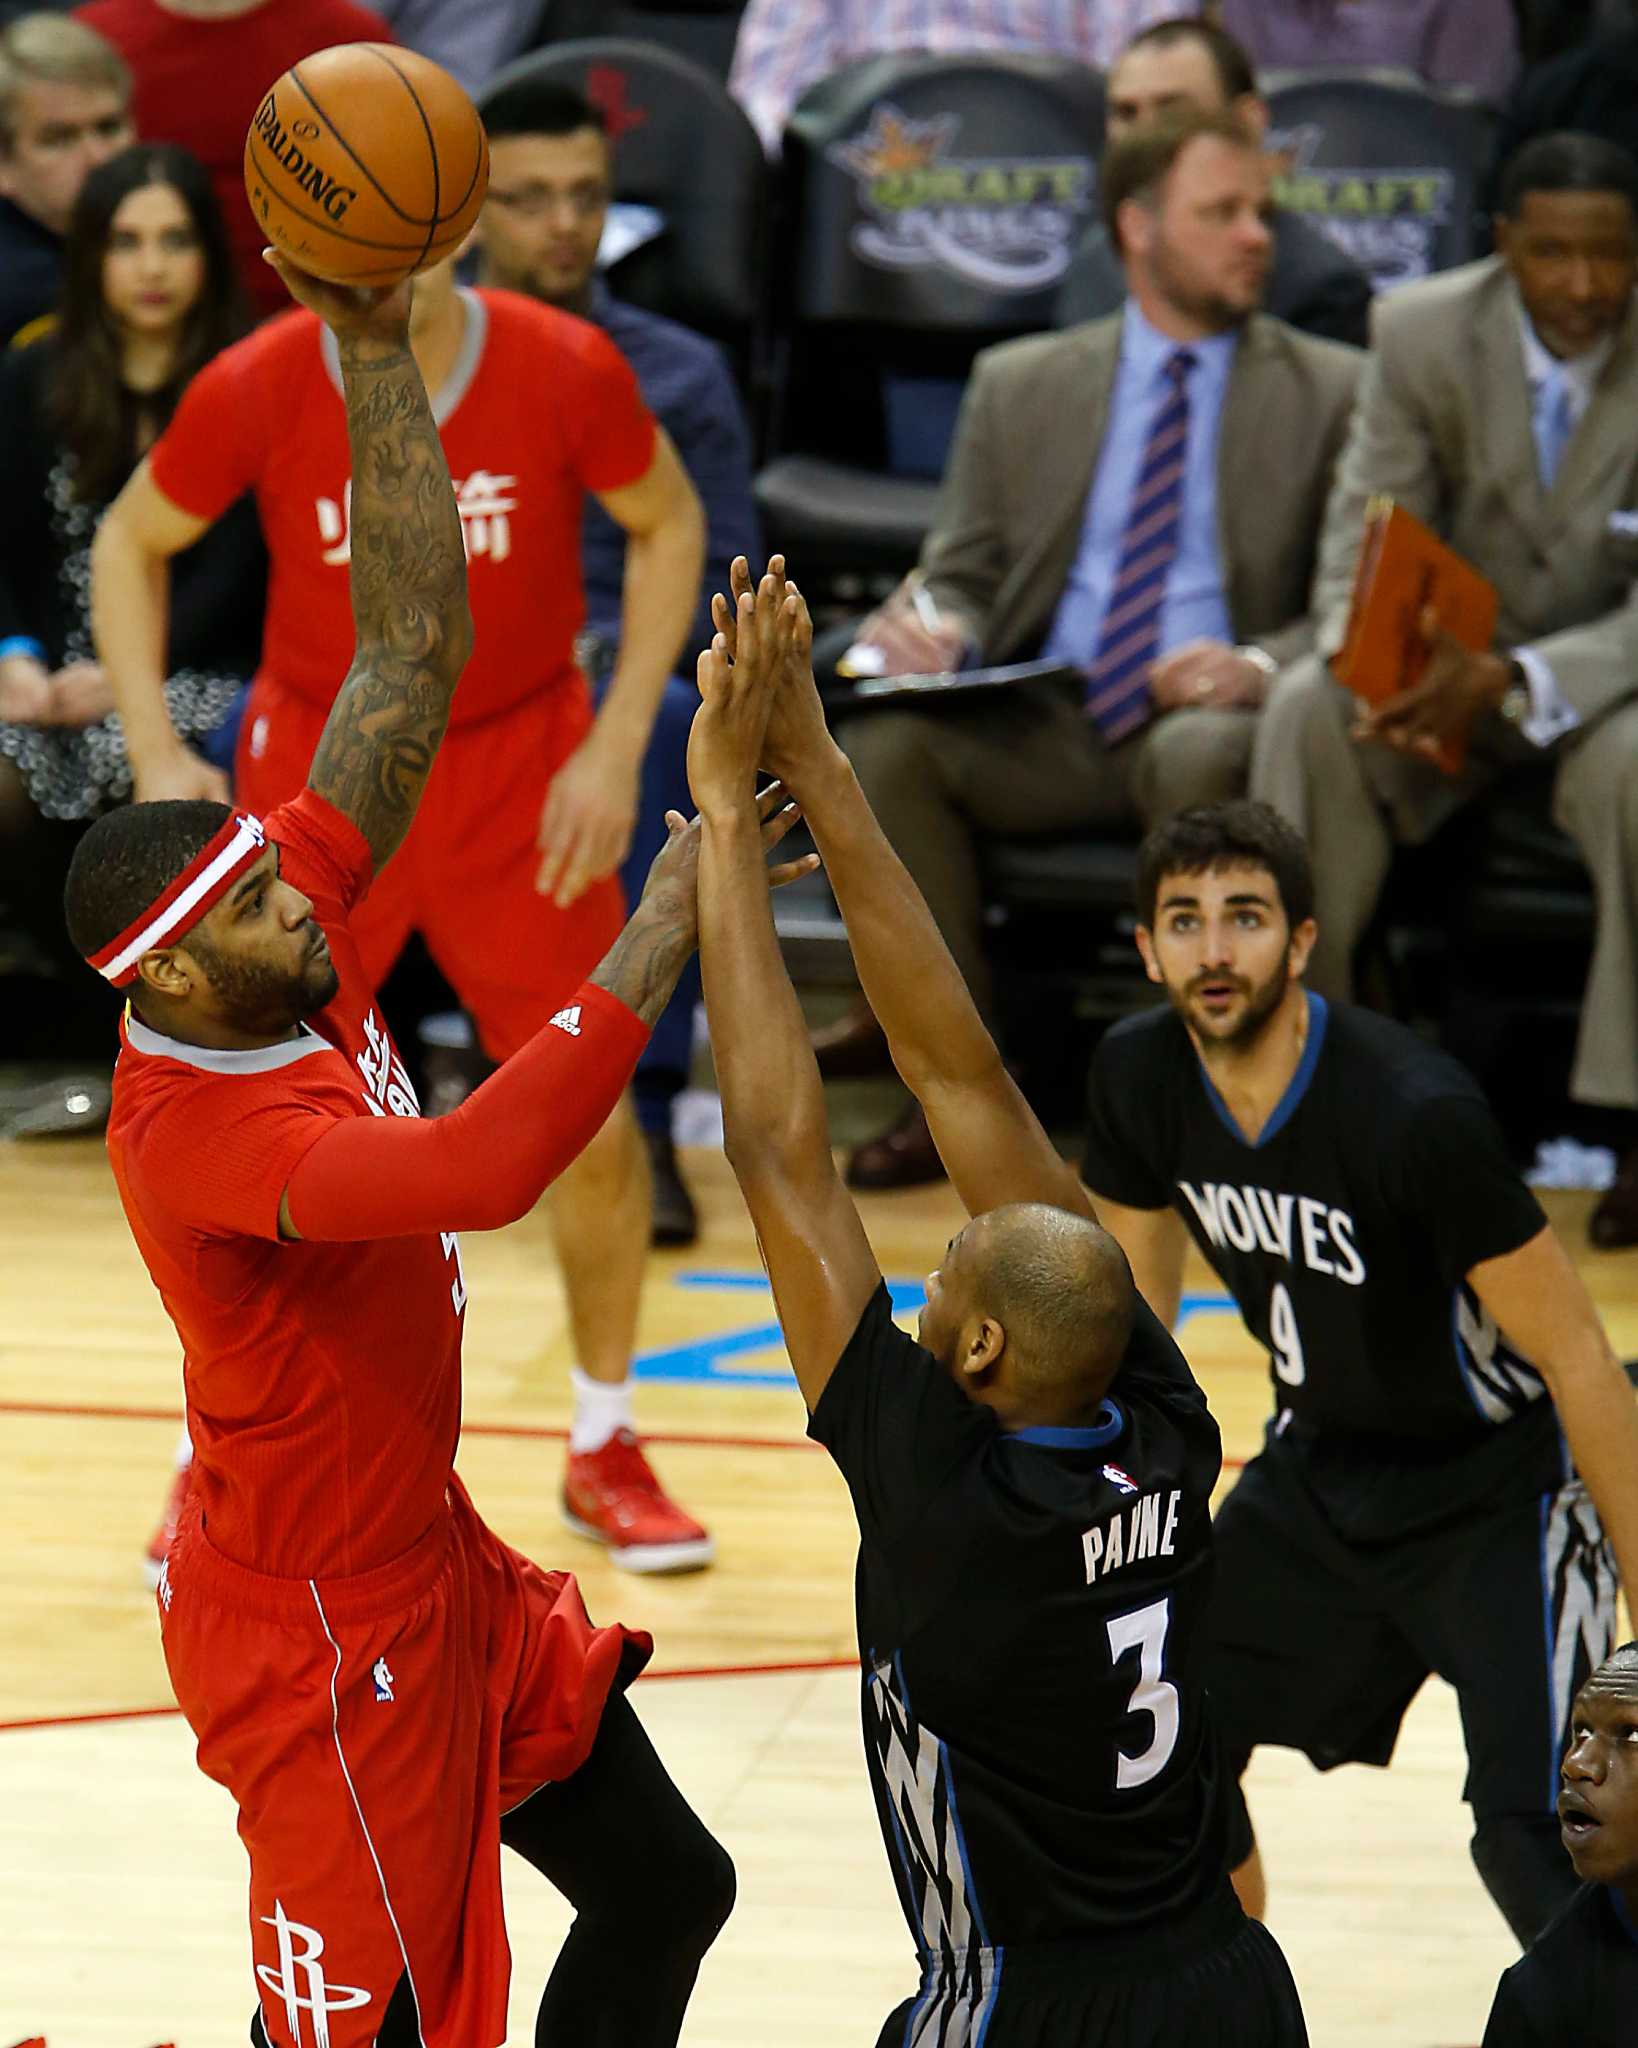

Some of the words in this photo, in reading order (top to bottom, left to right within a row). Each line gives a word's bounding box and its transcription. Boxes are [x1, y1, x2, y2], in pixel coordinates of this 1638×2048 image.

[254, 93, 357, 222] SPALDING
[1176, 1180, 1367, 1286] WOLVES
[1270, 1282, 1305, 1386] 9
[1106, 1598, 1180, 1789] 3
